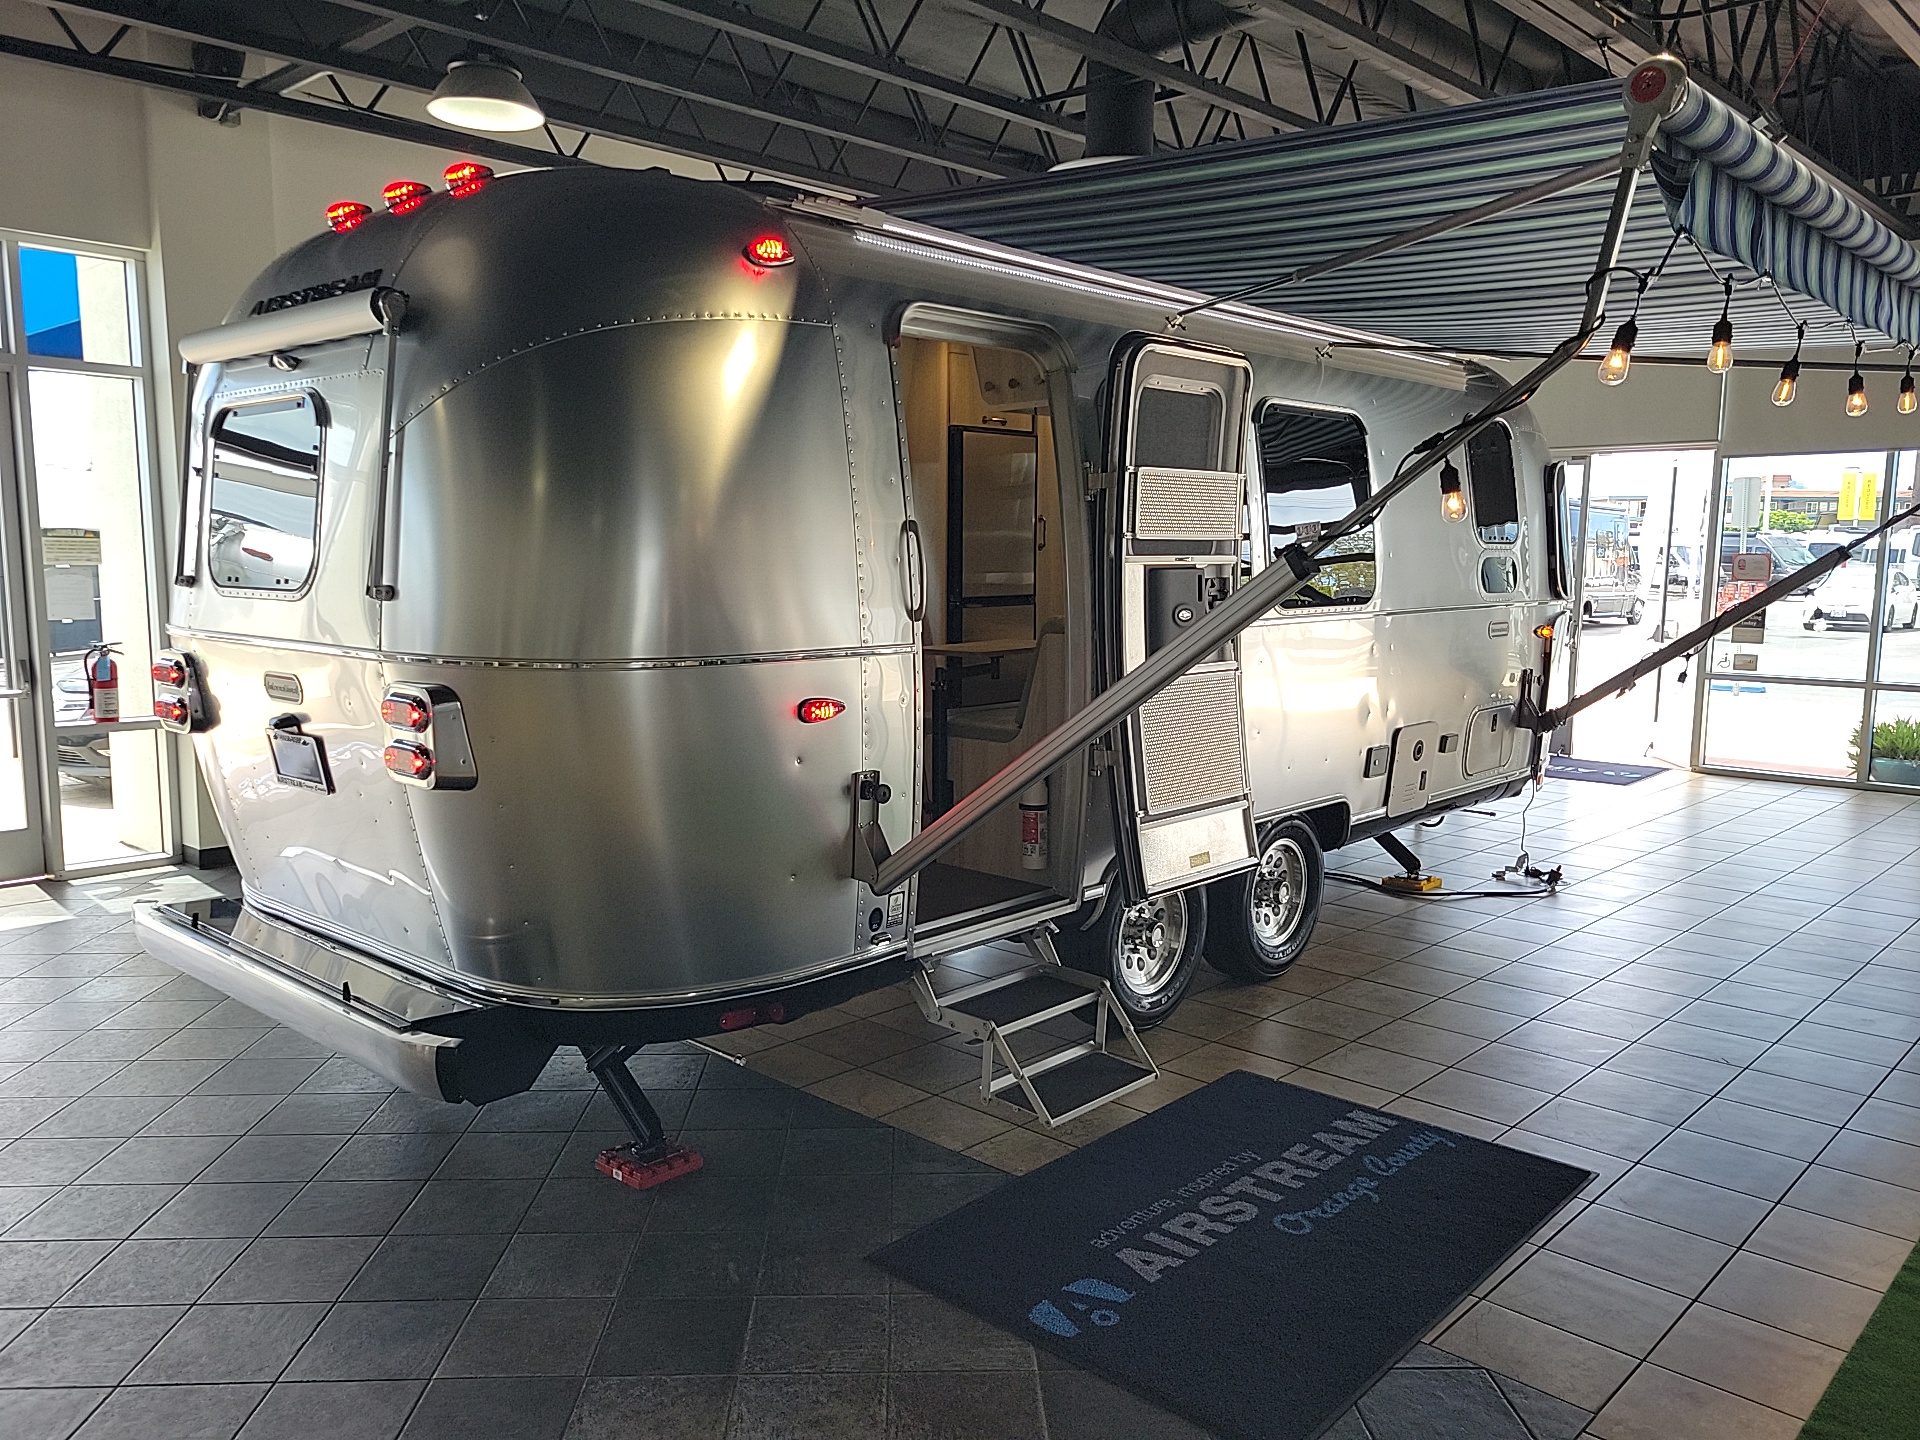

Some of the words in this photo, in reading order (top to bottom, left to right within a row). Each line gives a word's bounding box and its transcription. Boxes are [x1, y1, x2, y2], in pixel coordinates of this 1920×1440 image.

[1089, 1198, 1184, 1249] adventure,
[1172, 1159, 1239, 1198] inspired
[1229, 1149, 1262, 1164] by
[1114, 1109, 1399, 1283] AIRSTREAM
[1273, 1176, 1380, 1236] Orange
[1362, 1130, 1457, 1177] County
